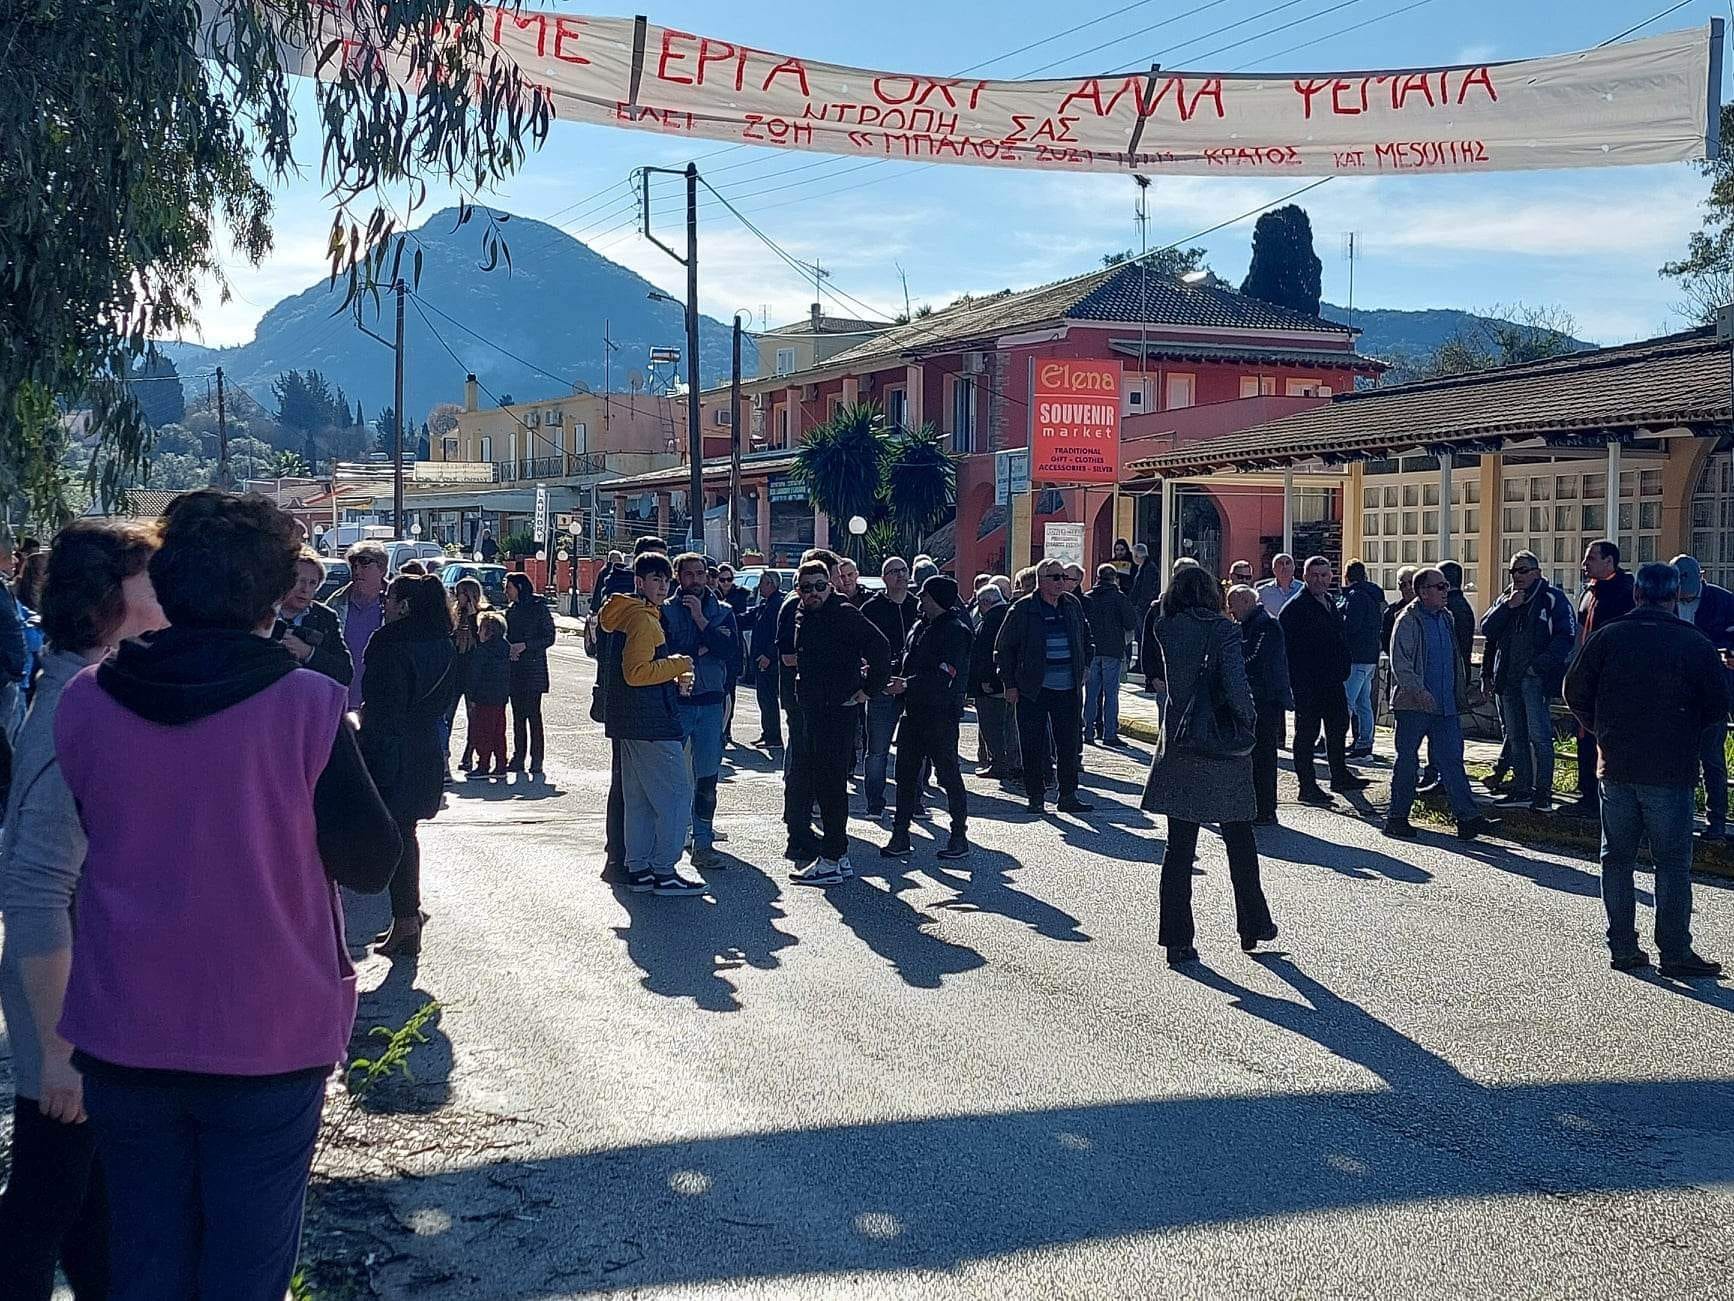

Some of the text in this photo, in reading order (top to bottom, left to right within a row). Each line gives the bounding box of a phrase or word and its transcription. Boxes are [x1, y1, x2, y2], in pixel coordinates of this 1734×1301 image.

[1058, 77, 1224, 121] ΑΛΛΑ
[743, 114, 812, 144] ΖΩΗ
[804, 102, 1079, 142] ΝΤΡΟΠΗ ΣΑΣ
[1041, 364, 1115, 391] Elena
[1040, 403, 1115, 426] SOUVENIR
[1042, 425, 1112, 439] market
[1050, 455, 1068, 463] GIFT
[1075, 456, 1104, 464] CLOTHES
[1055, 447, 1102, 455] TRADITIONAL
[1039, 464, 1086, 472] ACCESSORIES
[1092, 465, 1113, 473] SILVER
